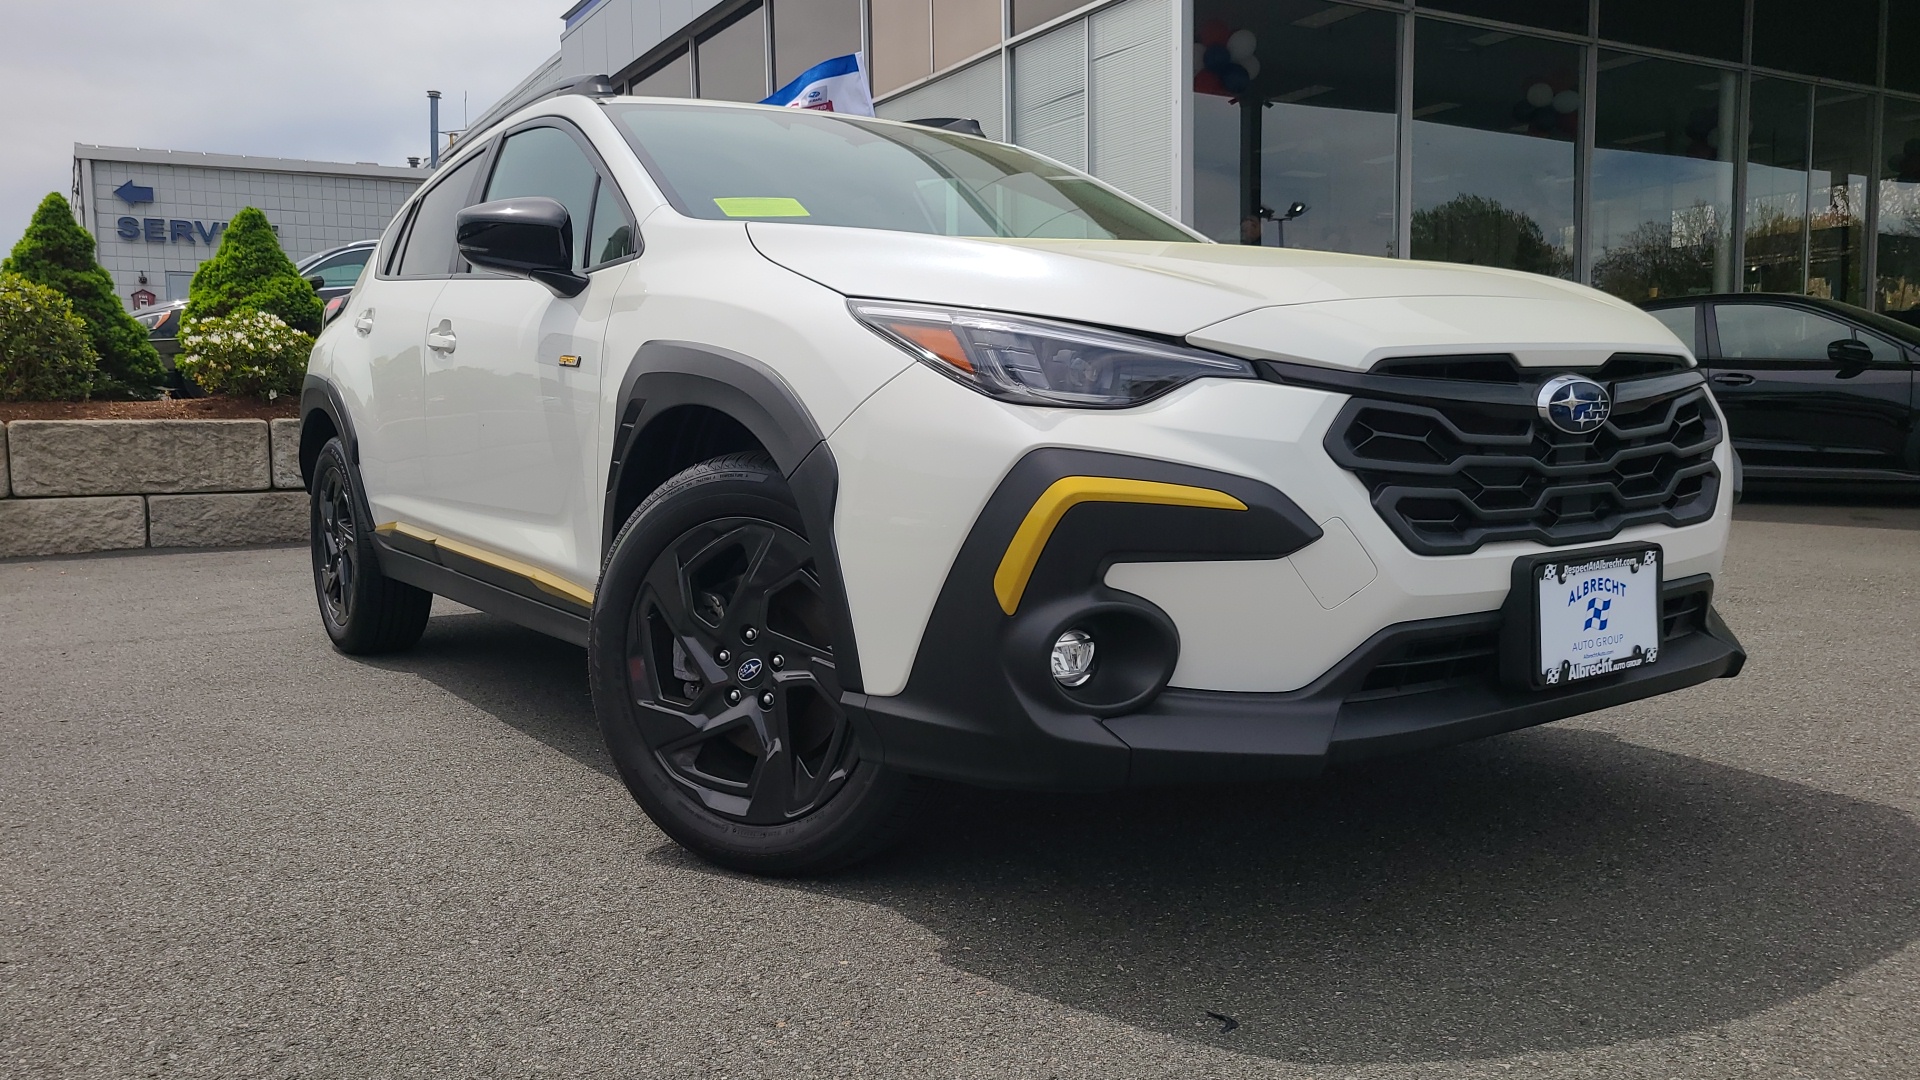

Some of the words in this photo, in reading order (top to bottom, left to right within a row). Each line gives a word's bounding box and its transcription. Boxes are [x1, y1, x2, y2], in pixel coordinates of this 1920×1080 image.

[117, 216, 279, 245] SERV
[1563, 557, 1637, 575] RespectAtAlbrecht.com
[1567, 577, 1627, 607] ALBRECHT
[1572, 640, 1594, 652] AUTO
[1596, 633, 1624, 647] GROUP
[1568, 658, 1613, 680] Albrecht
[1613, 662, 1626, 671] AUTO
[1626, 659, 1642, 668] GROUP
